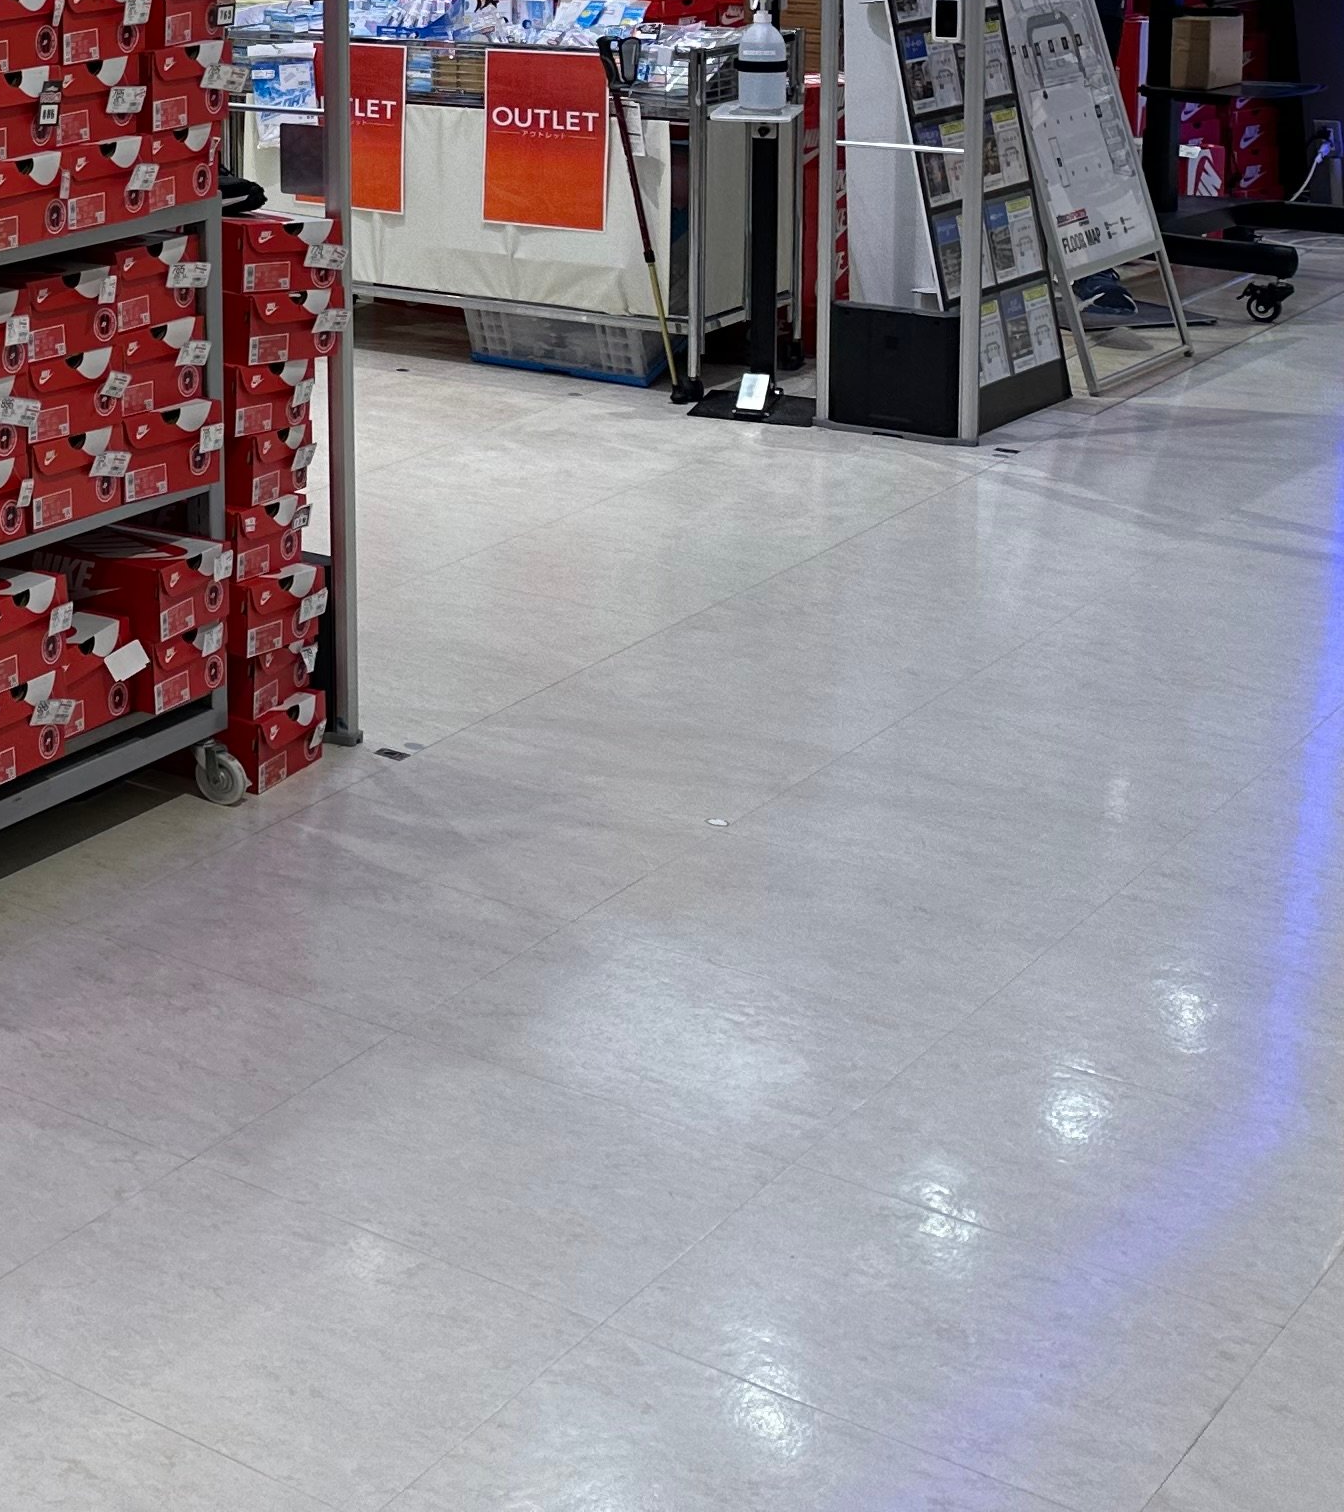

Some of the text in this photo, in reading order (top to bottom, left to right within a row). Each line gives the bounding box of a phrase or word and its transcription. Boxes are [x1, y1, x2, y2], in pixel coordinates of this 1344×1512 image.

[492, 106, 600, 132] OUTLET
[521, 130, 566, 139] アウトレット
